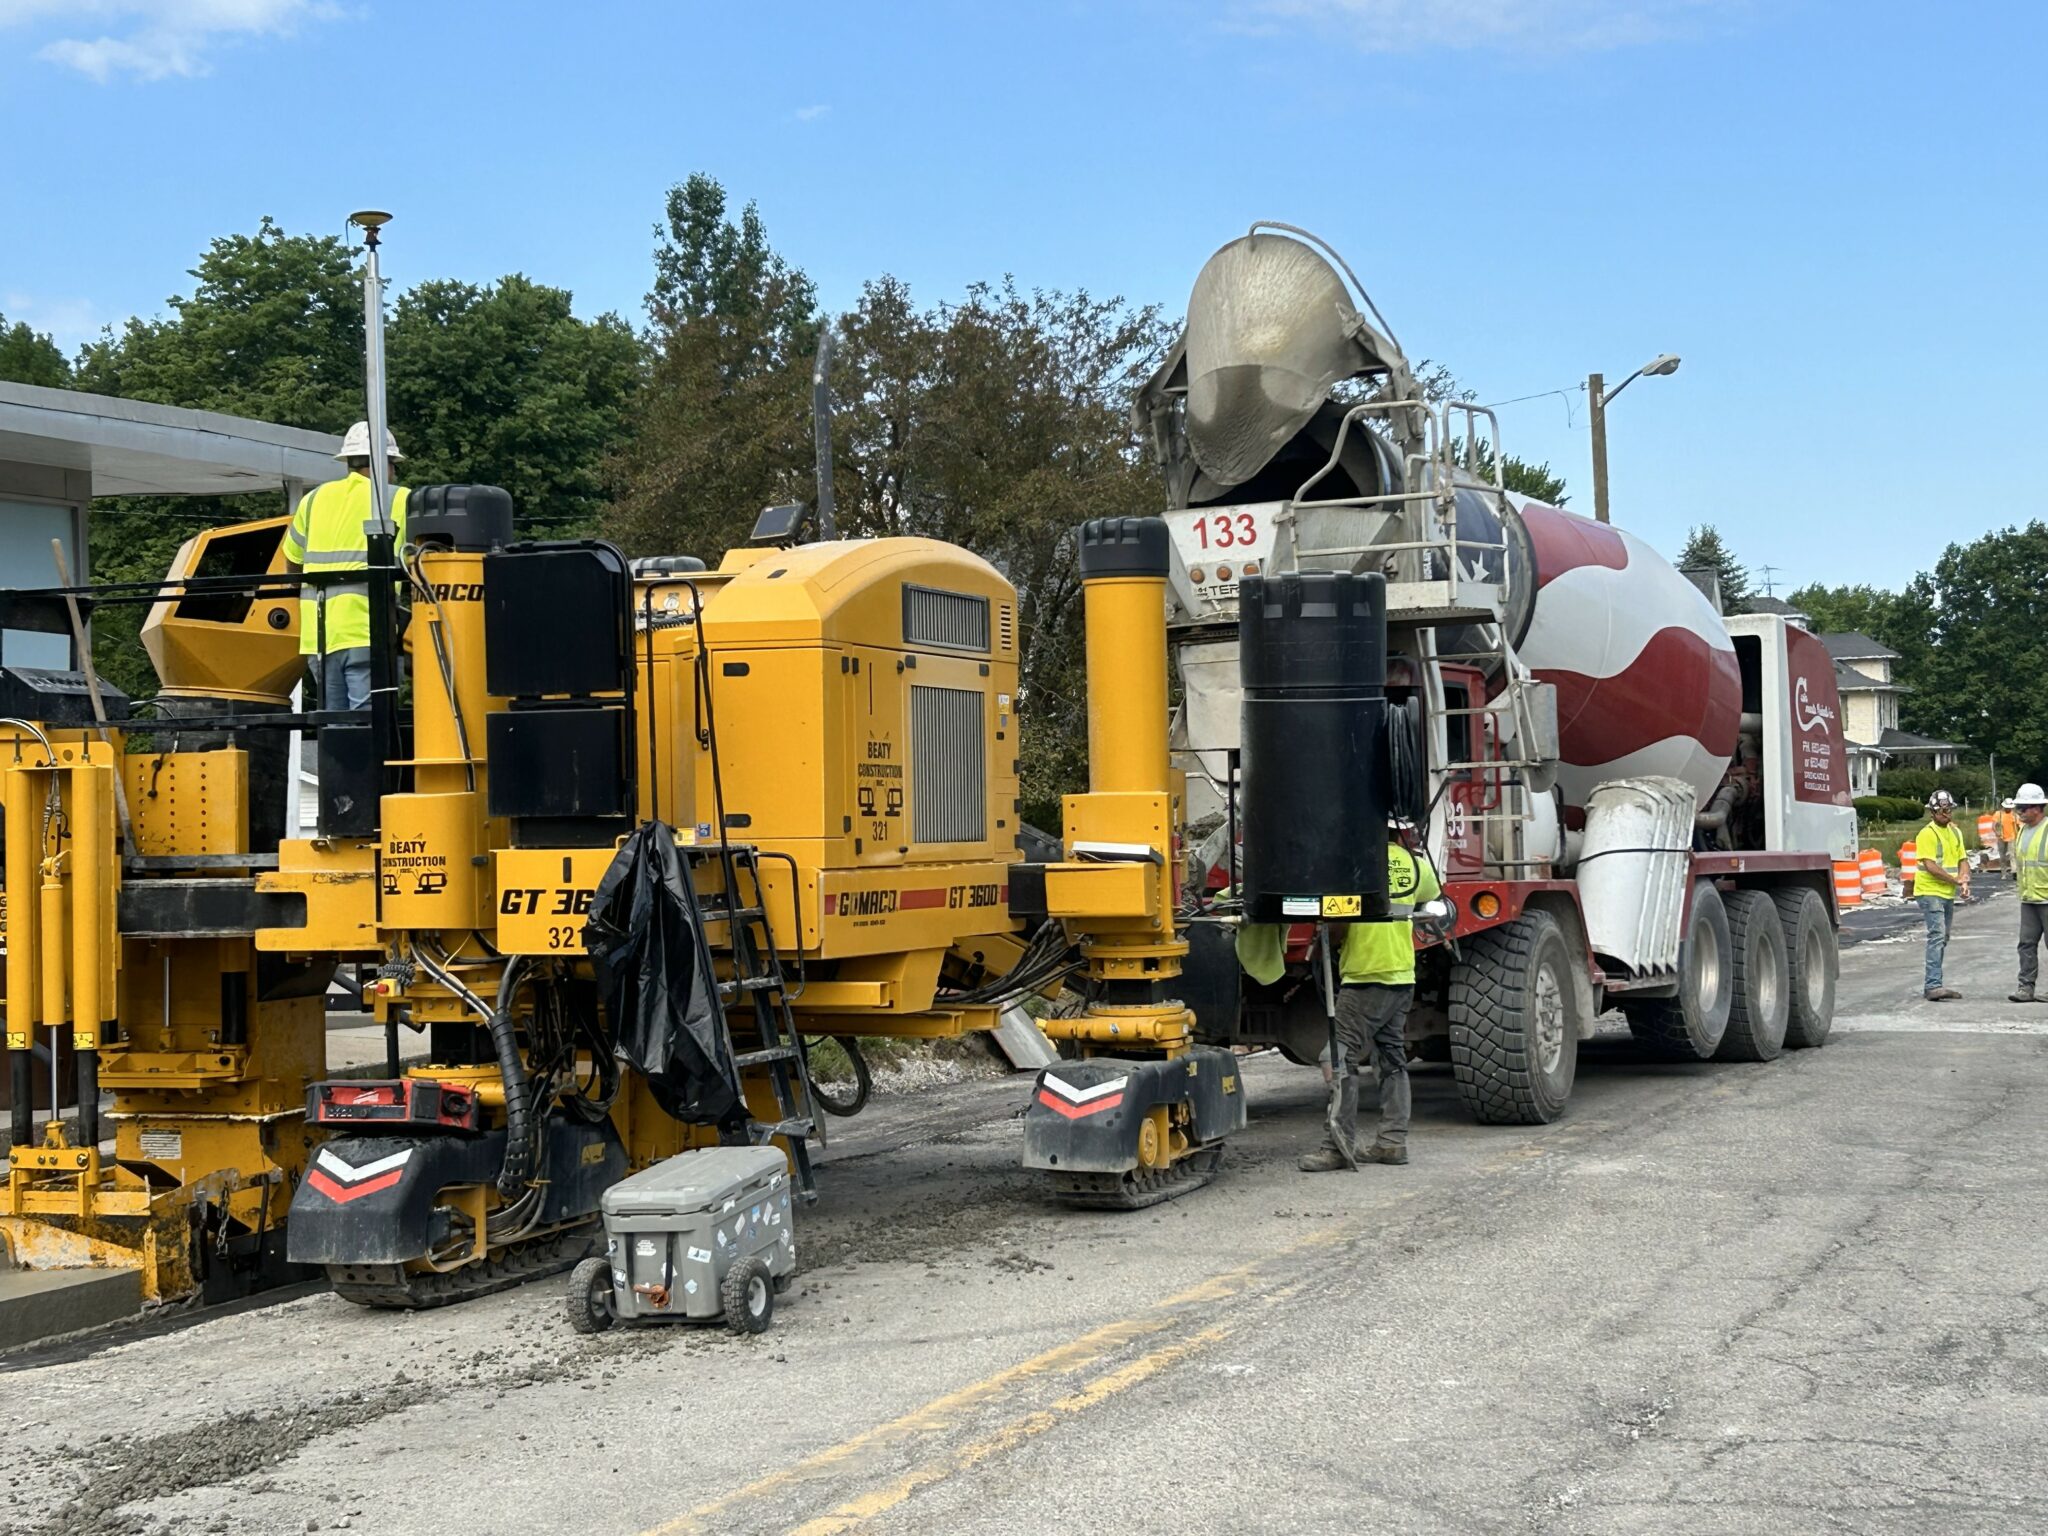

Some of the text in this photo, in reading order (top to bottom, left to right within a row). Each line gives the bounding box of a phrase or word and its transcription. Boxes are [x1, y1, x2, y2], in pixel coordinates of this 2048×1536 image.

[1193, 513, 1257, 549] 133
[868, 741, 891, 759] BEATY
[858, 763, 903, 778] CONSTRUCTION
[872, 821, 888, 841] 321
[390, 841, 426, 854] BEATY
[500, 889, 546, 914] GT
[839, 884, 998, 916] GOMACO GT 3600
